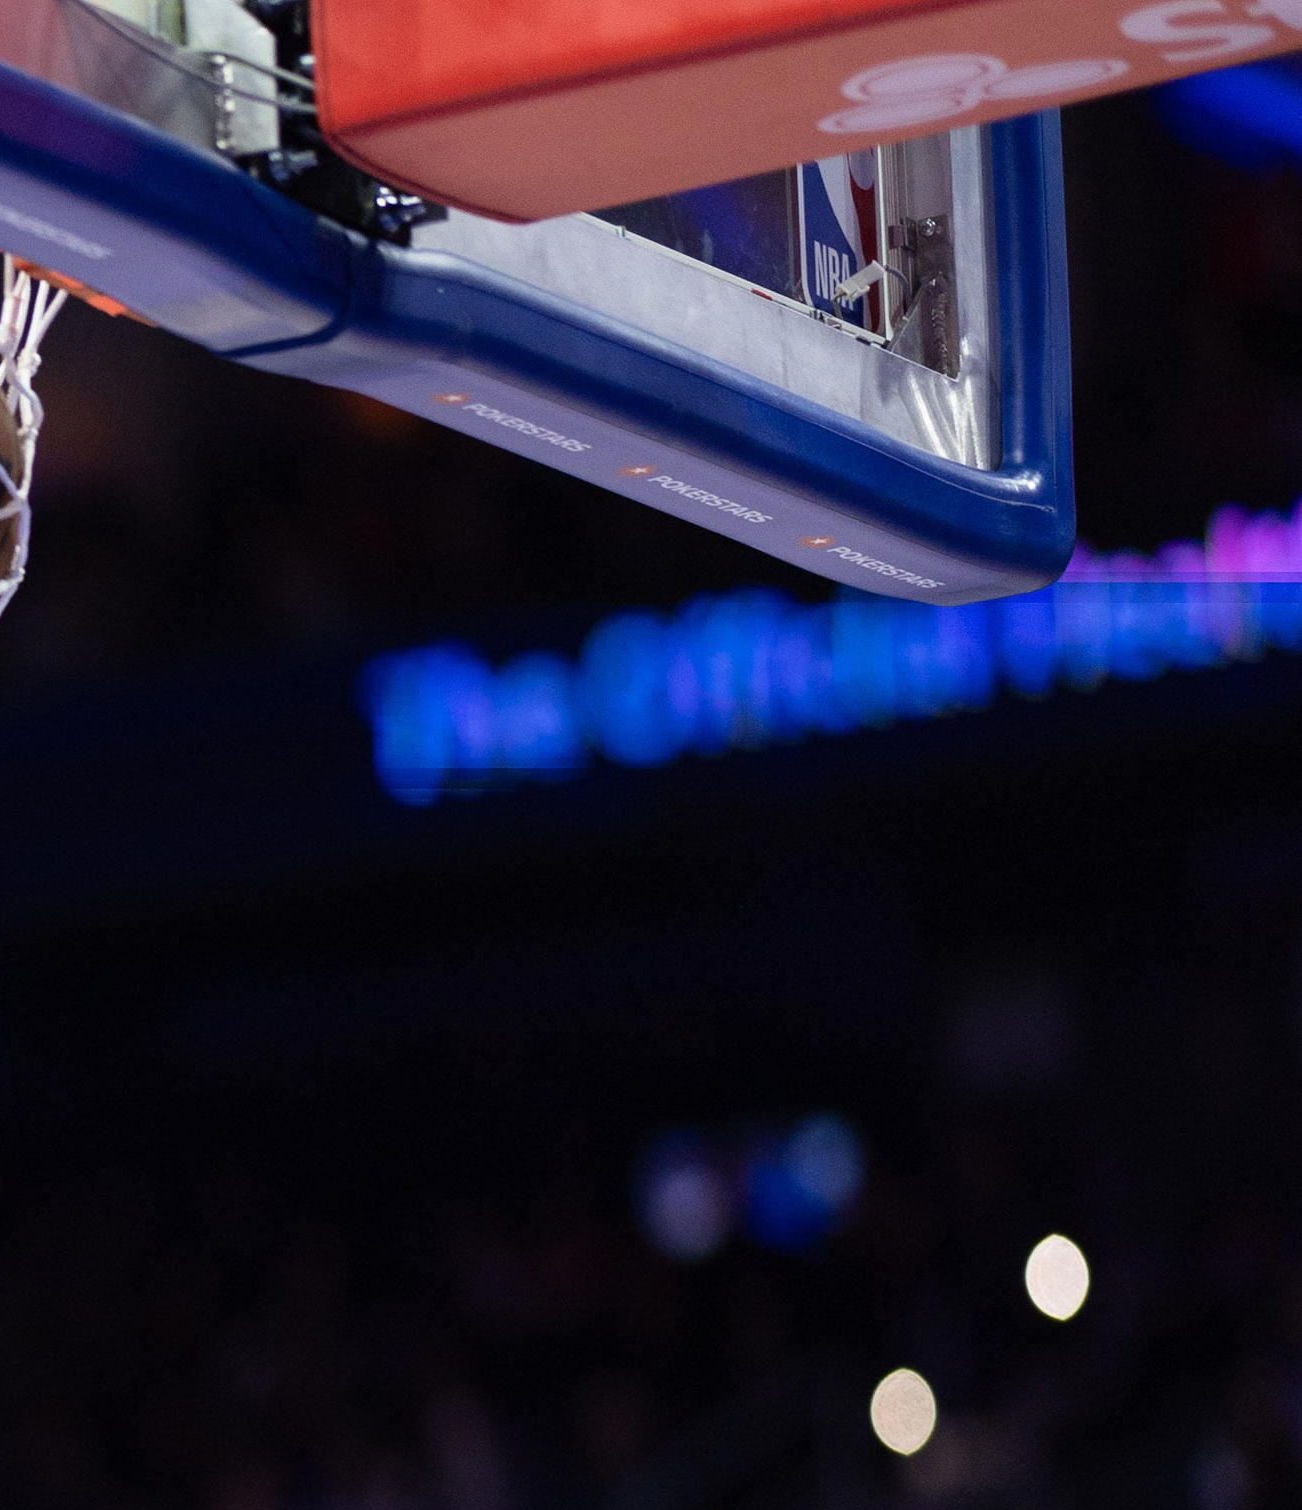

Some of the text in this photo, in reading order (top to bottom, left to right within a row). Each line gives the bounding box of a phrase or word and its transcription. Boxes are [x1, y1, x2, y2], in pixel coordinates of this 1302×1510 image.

[462, 403, 592, 452] POKERSTARS
[648, 474, 774, 524] POKERSTARS
[827, 546, 945, 590] POKERSTARS
